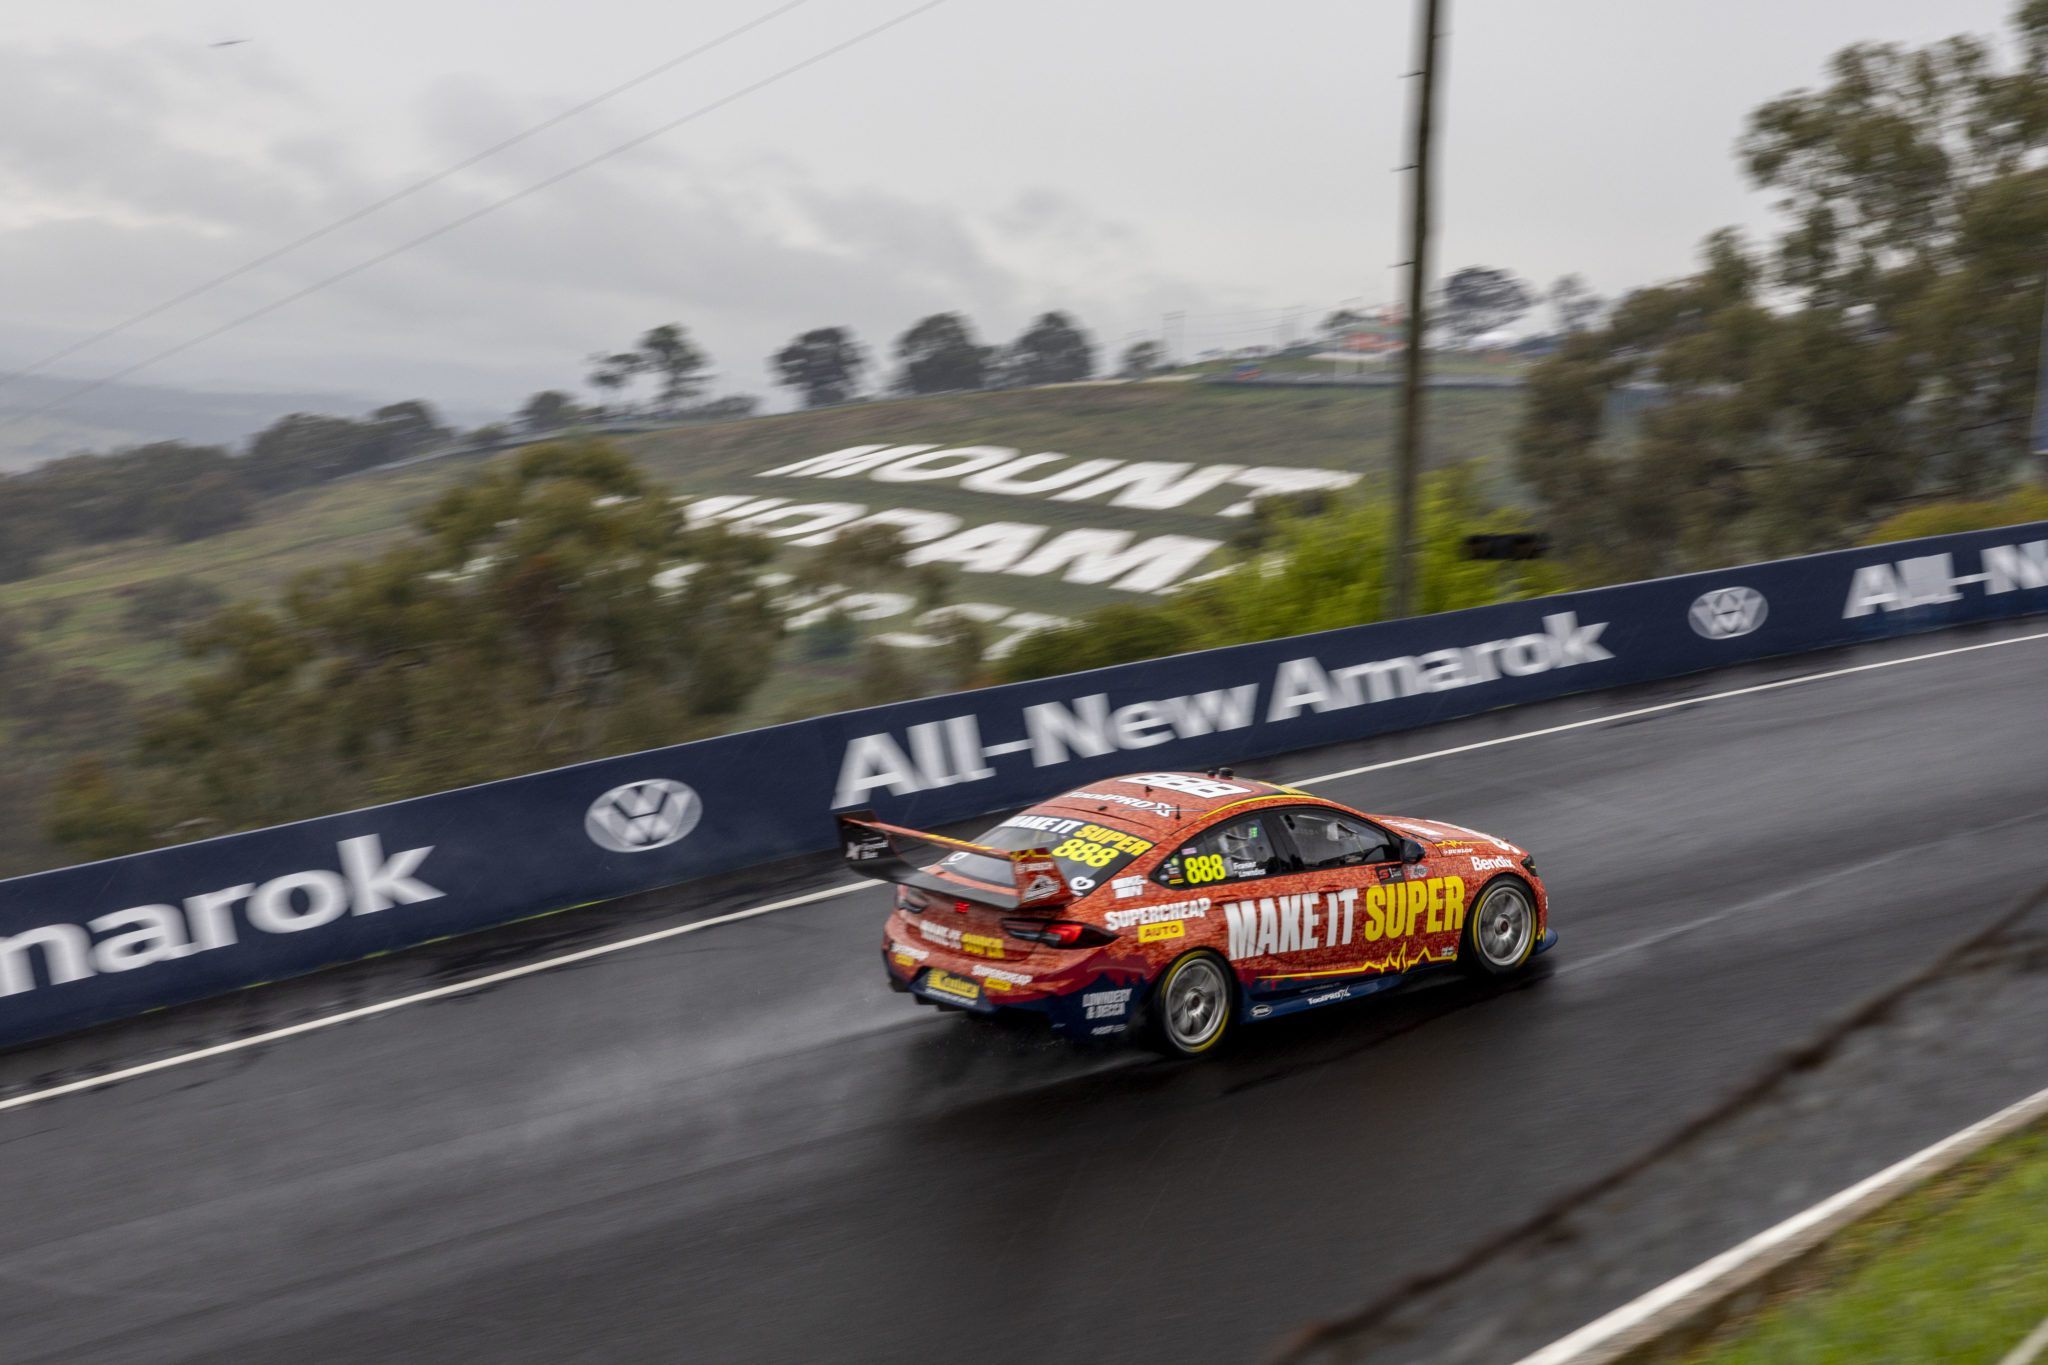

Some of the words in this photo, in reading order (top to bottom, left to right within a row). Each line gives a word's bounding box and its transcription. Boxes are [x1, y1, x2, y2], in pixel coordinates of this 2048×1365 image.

[752, 443, 1363, 517] MOUNT
[831, 682, 1259, 810] All-New
[1265, 611, 1614, 724] Amarok
[1048, 819, 1085, 834] IT
[1073, 824, 1154, 856] SUPER
[1052, 838, 1120, 868] 888
[1184, 853, 1226, 884] 888
[1470, 855, 1516, 872] Bendix
[1104, 897, 1212, 931] SUPERCHEAP
[1222, 892, 1319, 961] MAKE
[1326, 887, 1359, 948] IT
[1364, 875, 1465, 942] SUPER
[1143, 925, 1180, 938] AUTO
